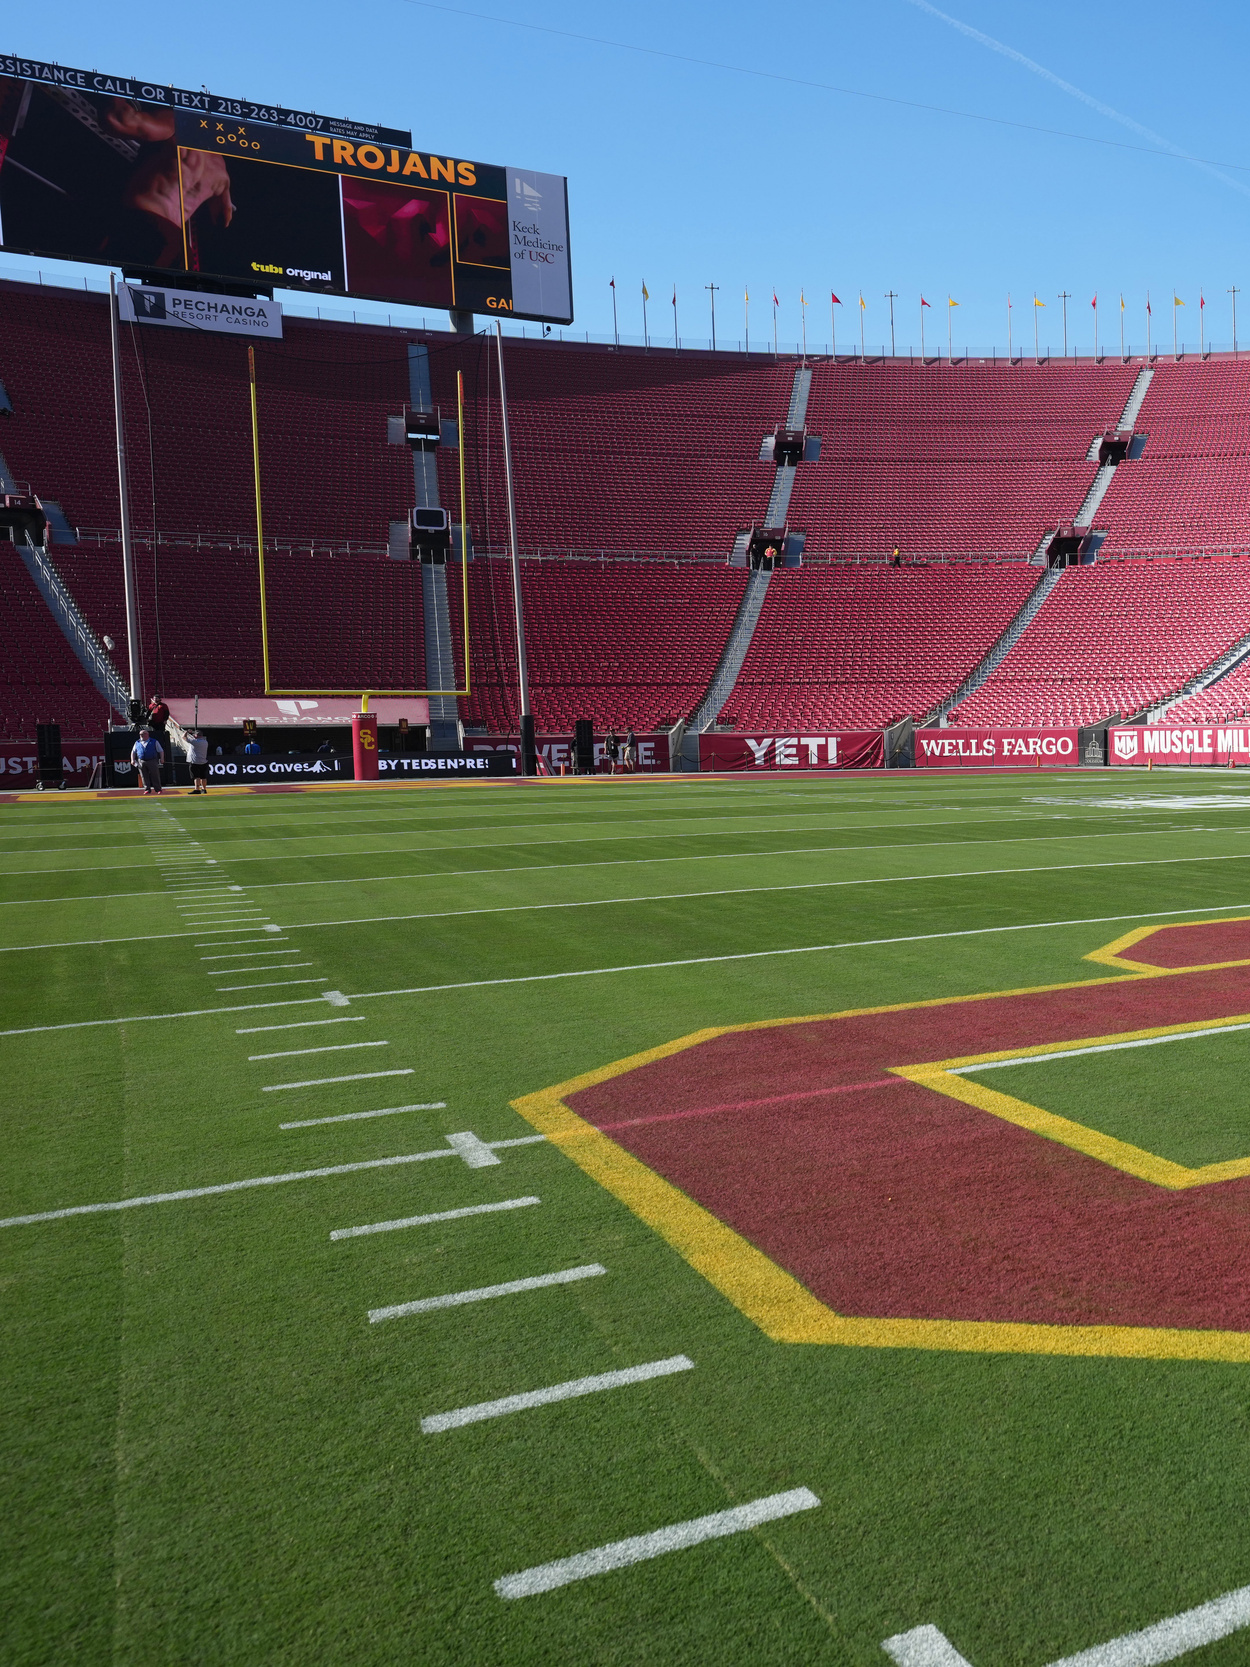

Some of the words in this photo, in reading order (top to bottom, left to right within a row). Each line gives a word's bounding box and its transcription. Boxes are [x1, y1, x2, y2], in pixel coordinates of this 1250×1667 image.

[93, 76, 134, 96] CALL
[141, 86, 165, 101] OR
[172, 90, 210, 109] TEXT
[218, 99, 324, 130] 213-263-4007
[330, 120, 352, 130] MESSAGE
[330, 126, 345, 135] RATES
[359, 132, 375, 140] APPLY
[305, 133, 477, 187] TROJANS
[512, 220, 540, 235] Keck
[513, 234, 564, 252] Medicine
[513, 249, 526, 260] of
[528, 250, 555, 264] USC
[251, 261, 283, 275] tubi
[285, 266, 332, 281] original
[172, 297, 267, 319] PECHANGA
[172, 310, 218, 322] RESORT
[225, 316, 269, 328] CASINO
[921, 738, 996, 757] WELLS
[1002, 737, 1073, 756] FARGO
[1144, 729, 1213, 753] MUSCLE
[744, 737, 838, 765] YETI
[378, 759, 398, 770] BY
